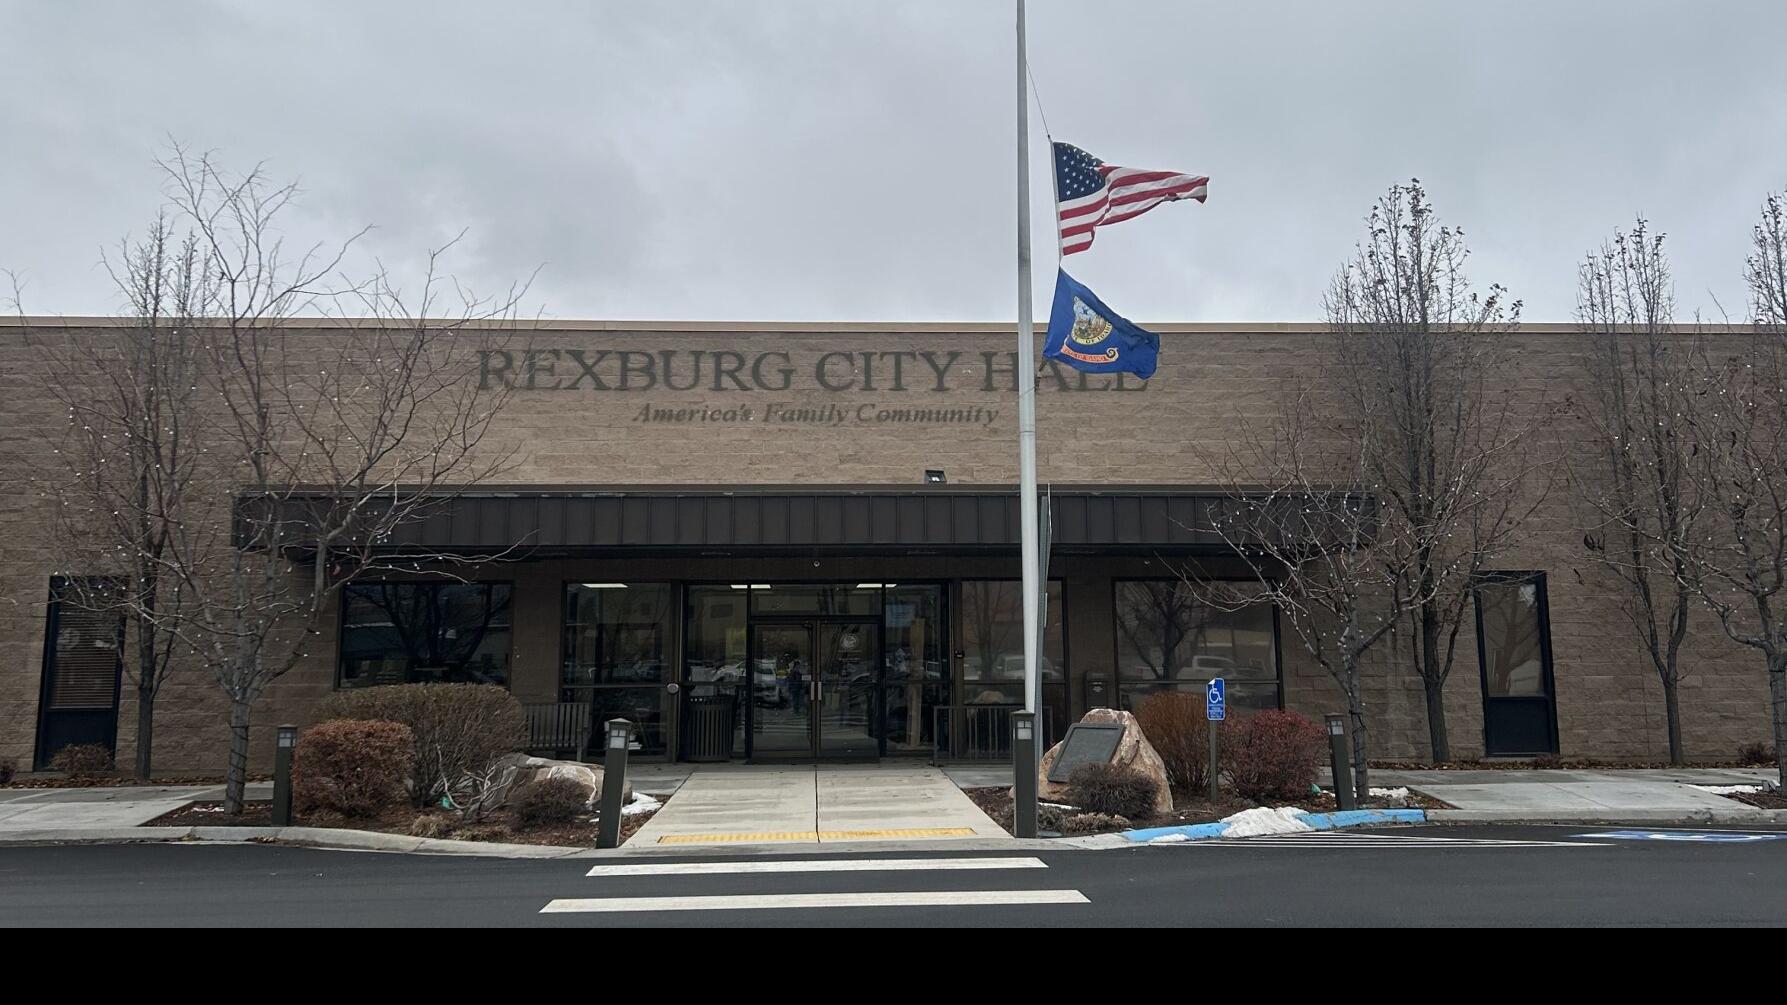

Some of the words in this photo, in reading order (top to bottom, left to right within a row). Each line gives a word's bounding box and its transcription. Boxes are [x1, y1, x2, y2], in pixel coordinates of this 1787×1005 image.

[477, 350, 796, 391] REXBURG
[815, 350, 963, 391] CITY
[632, 402, 753, 423] America's
[762, 402, 848, 427] Family
[856, 402, 999, 428] Community
